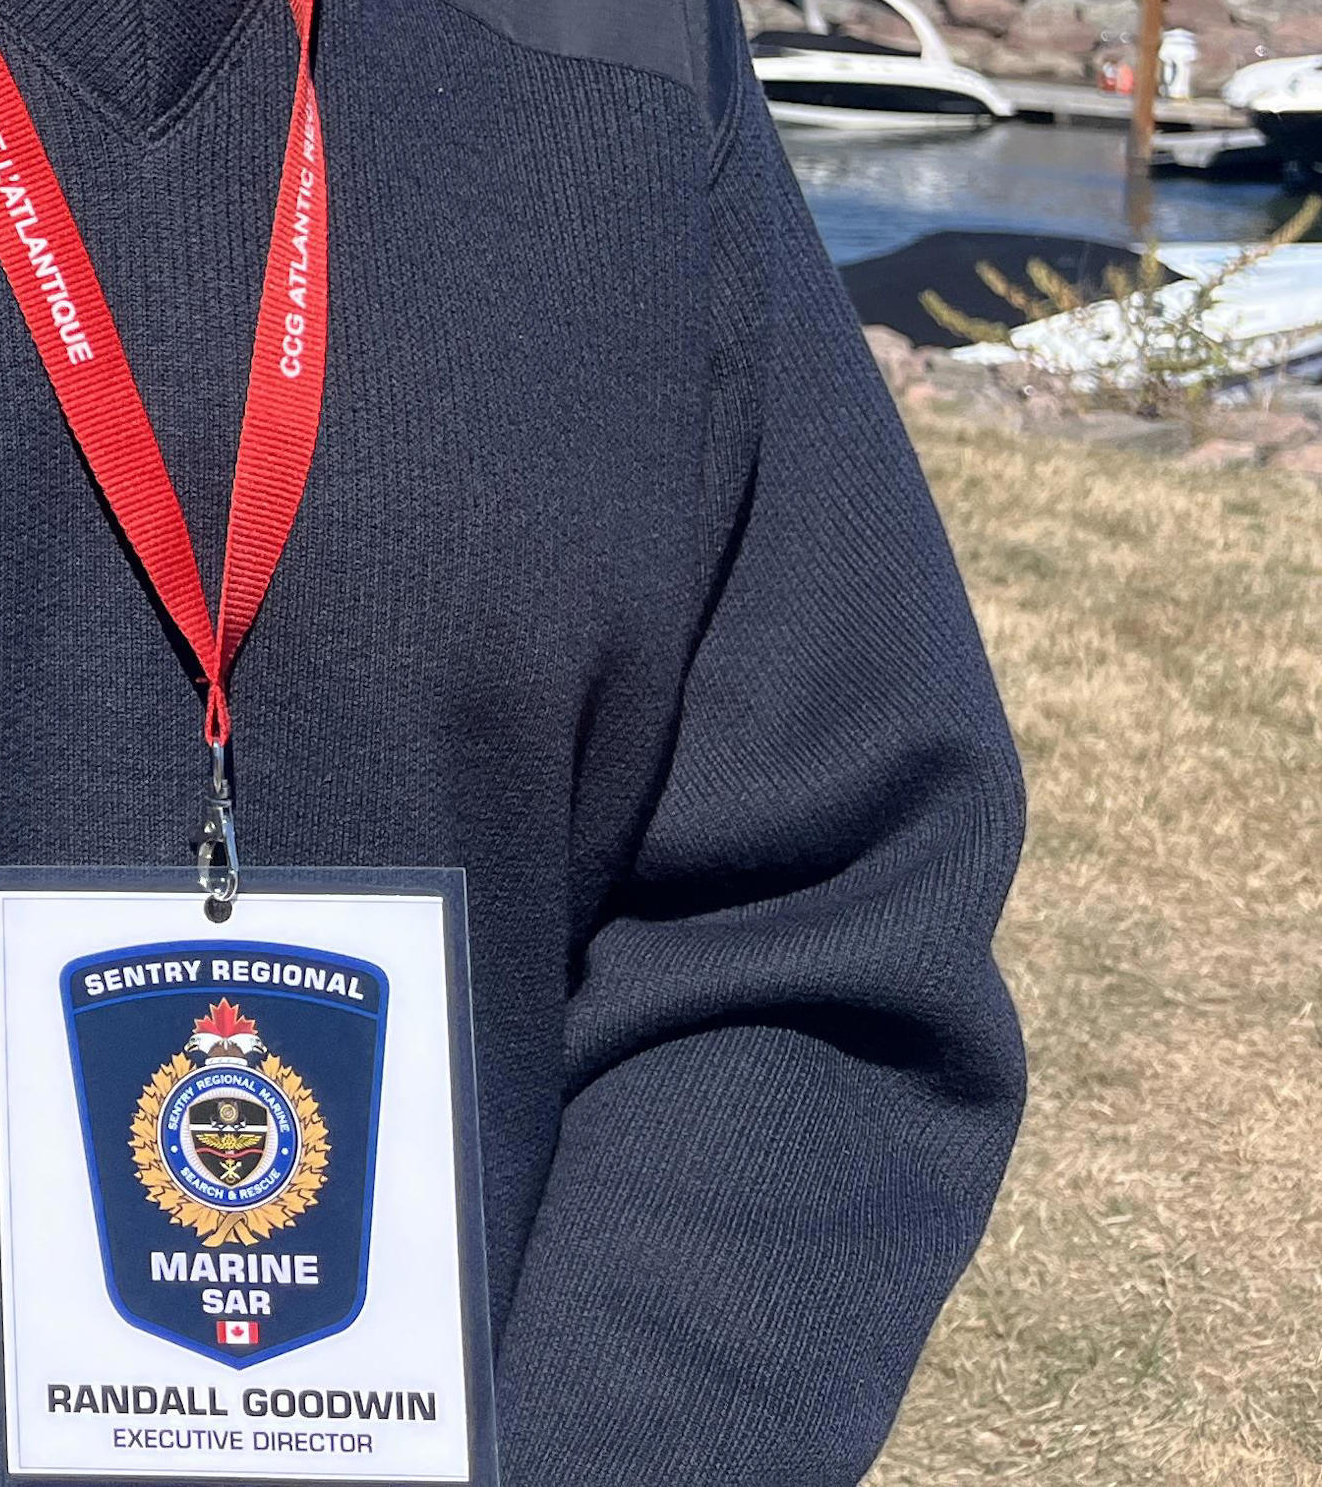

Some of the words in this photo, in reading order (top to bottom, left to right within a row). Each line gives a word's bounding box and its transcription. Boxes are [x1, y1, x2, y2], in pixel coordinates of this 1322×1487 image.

[288, 167, 314, 309] ATLANTIC
[279, 312, 305, 378] CCG
[84, 960, 201, 996] SENTRY
[211, 959, 364, 1000] REGIONAL
[167, 1086, 195, 1131] SENTRY
[195, 1074, 256, 1093] REGIONAL
[258, 1088, 290, 1133] MARINE
[180, 1166, 224, 1200] SEARCH
[227, 1190, 238, 1201] &
[239, 1168, 281, 1200] RESCUE
[150, 1251, 319, 1285] MARINE
[202, 1288, 271, 1316] SAR
[47, 1383, 229, 1417] RANDALL
[242, 1387, 437, 1422] GOODWIN
[113, 1427, 243, 1451] EXECUTIVE
[252, 1430, 373, 1454] DIRECTOR
